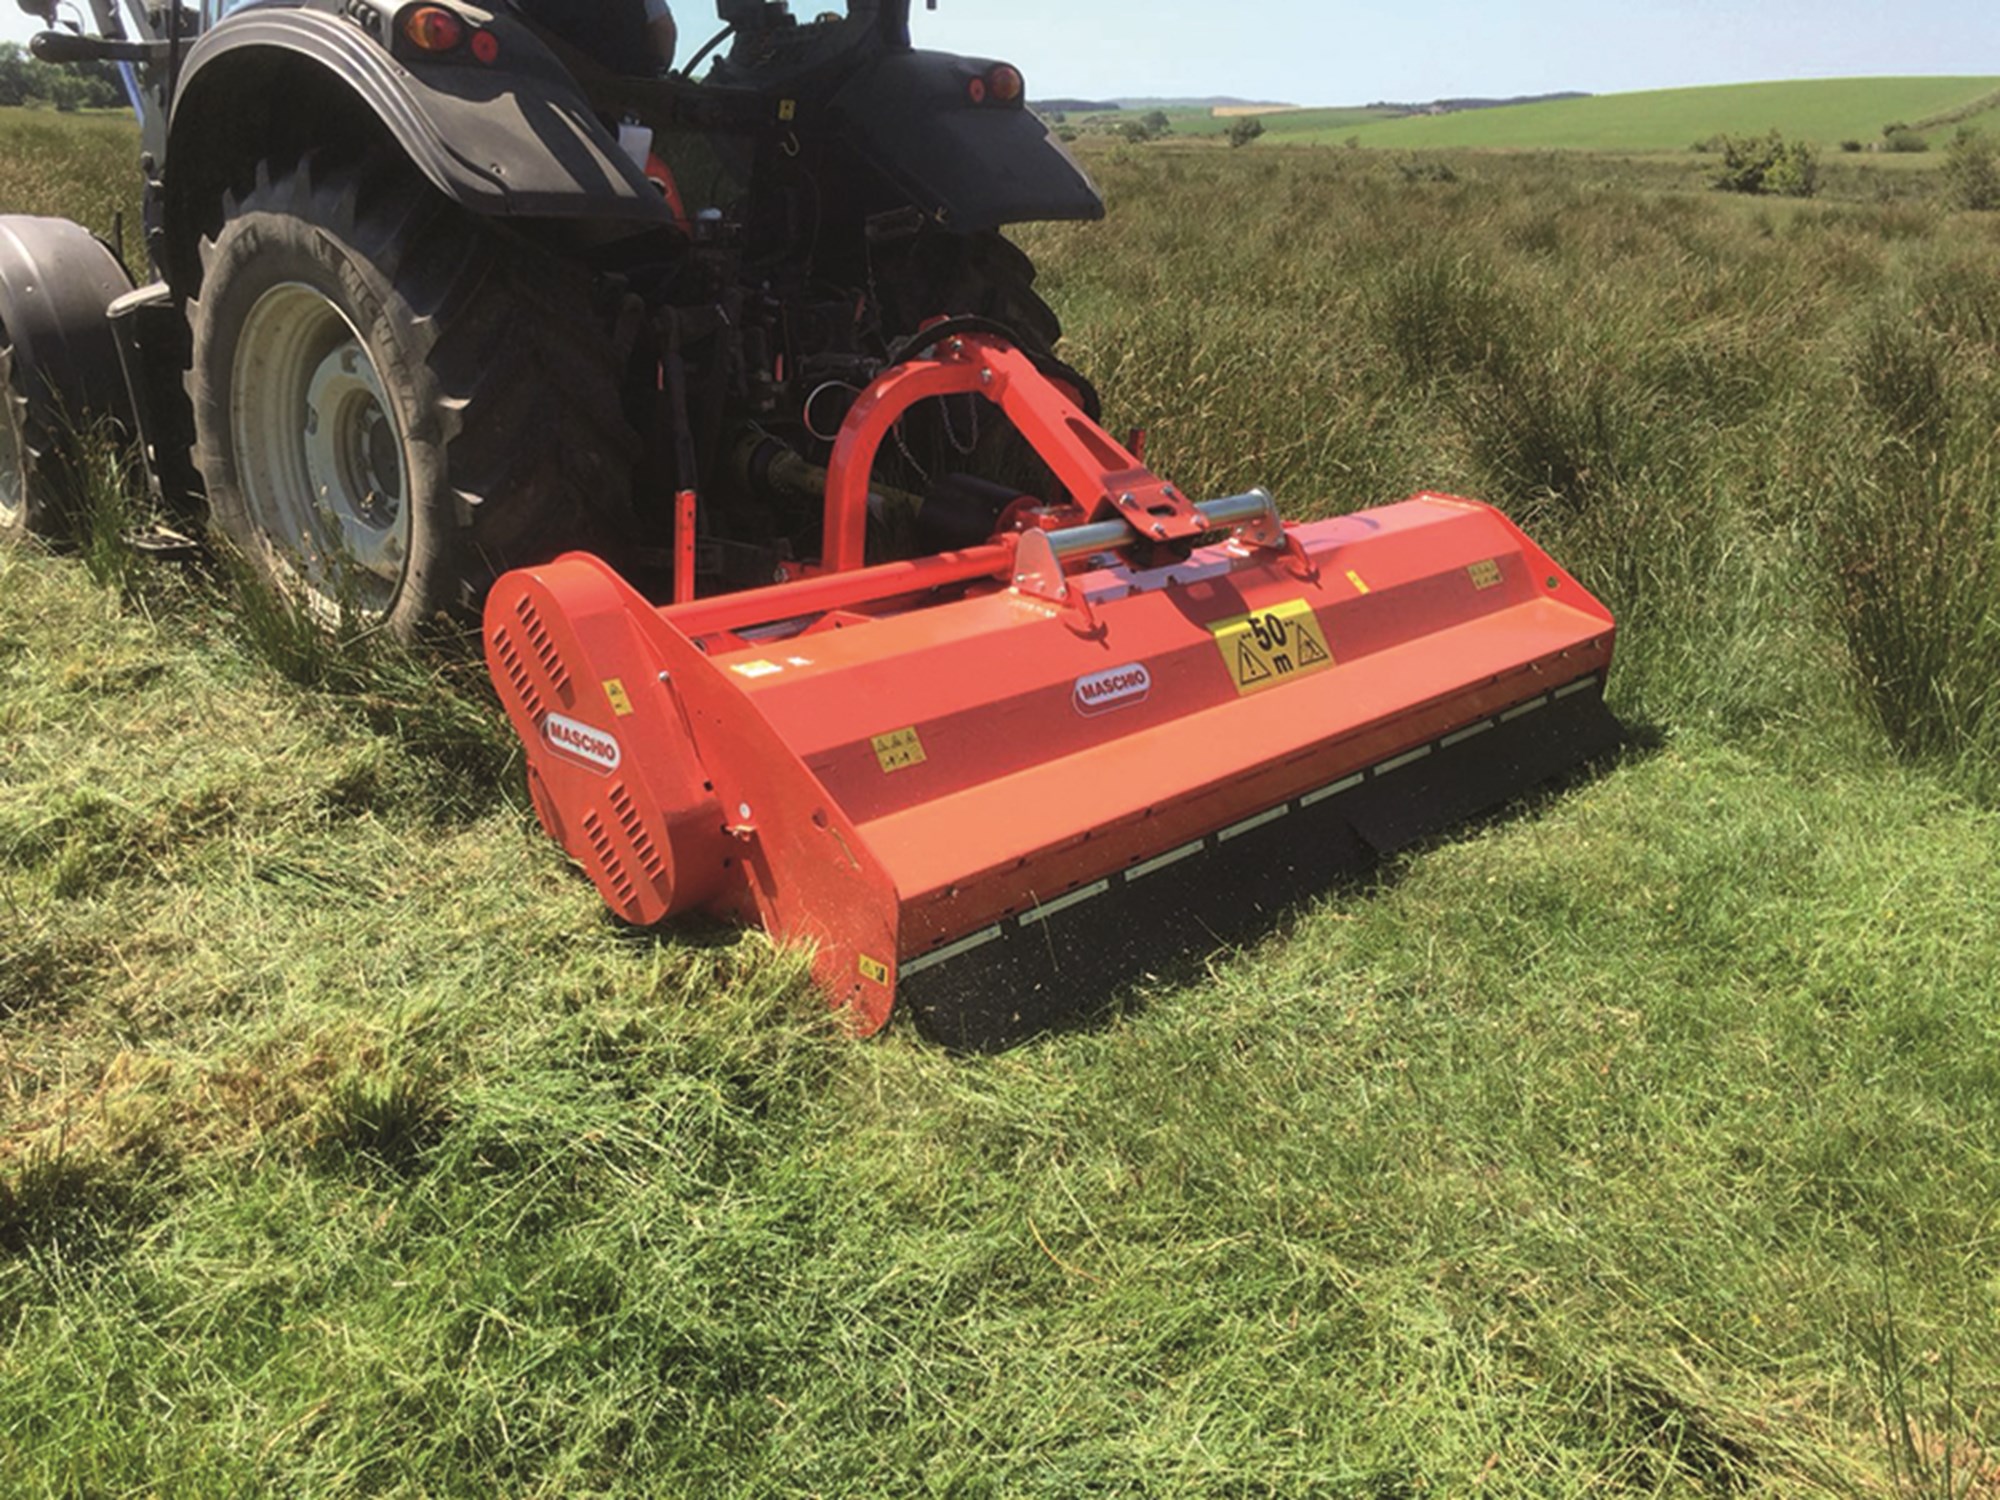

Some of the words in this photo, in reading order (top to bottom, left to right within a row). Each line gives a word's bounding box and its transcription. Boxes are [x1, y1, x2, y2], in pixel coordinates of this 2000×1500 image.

[1248, 613, 1287, 651] 50
[1272, 653, 1294, 675] m
[1081, 669, 1146, 700] MASCHIO
[550, 721, 616, 761] MASCHIO
